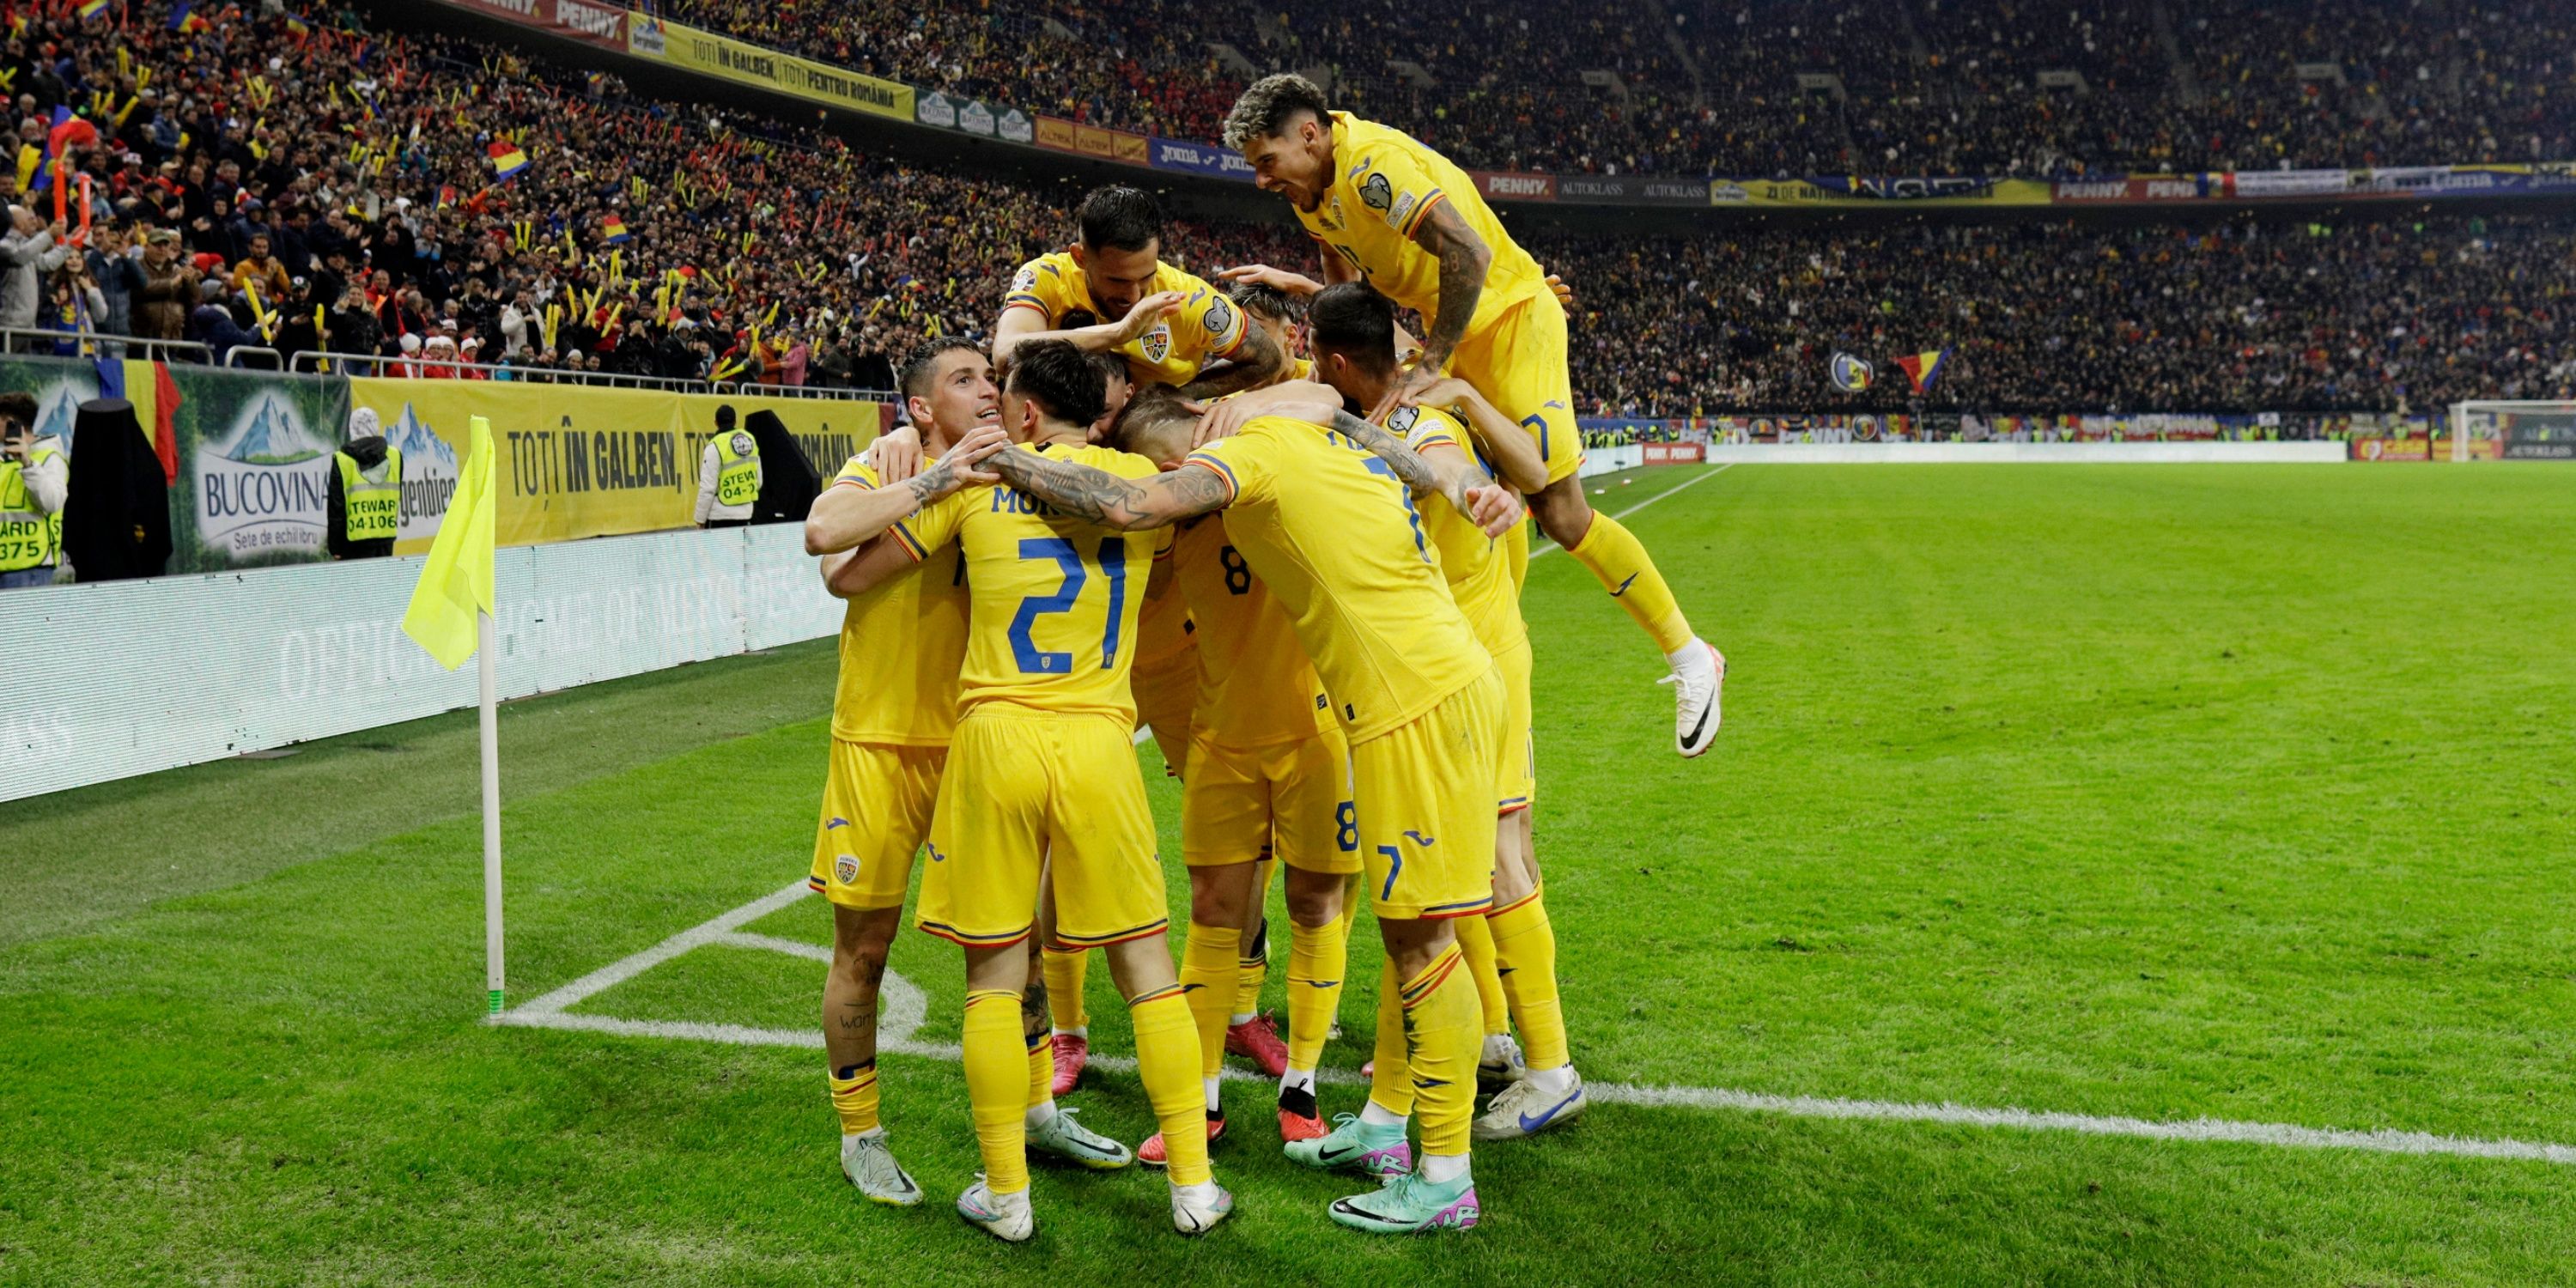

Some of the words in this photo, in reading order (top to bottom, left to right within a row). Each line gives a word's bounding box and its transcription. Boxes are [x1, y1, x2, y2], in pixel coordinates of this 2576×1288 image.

[807, 72, 849, 97] PENTRU
[1561, 180, 1623, 196] AUTOKLASS
[1643, 184, 1705, 198] AUTOKLASS
[561, 415, 591, 493] ÎN
[593, 429, 682, 495] GALBEN,
[234, 532, 258, 550] Sete
[260, 527, 273, 546] de
[1220, 545, 1251, 595] 8
[1007, 537, 1127, 674] 21
[1335, 800, 1359, 852] 8
[1377, 845, 1402, 901] 7
